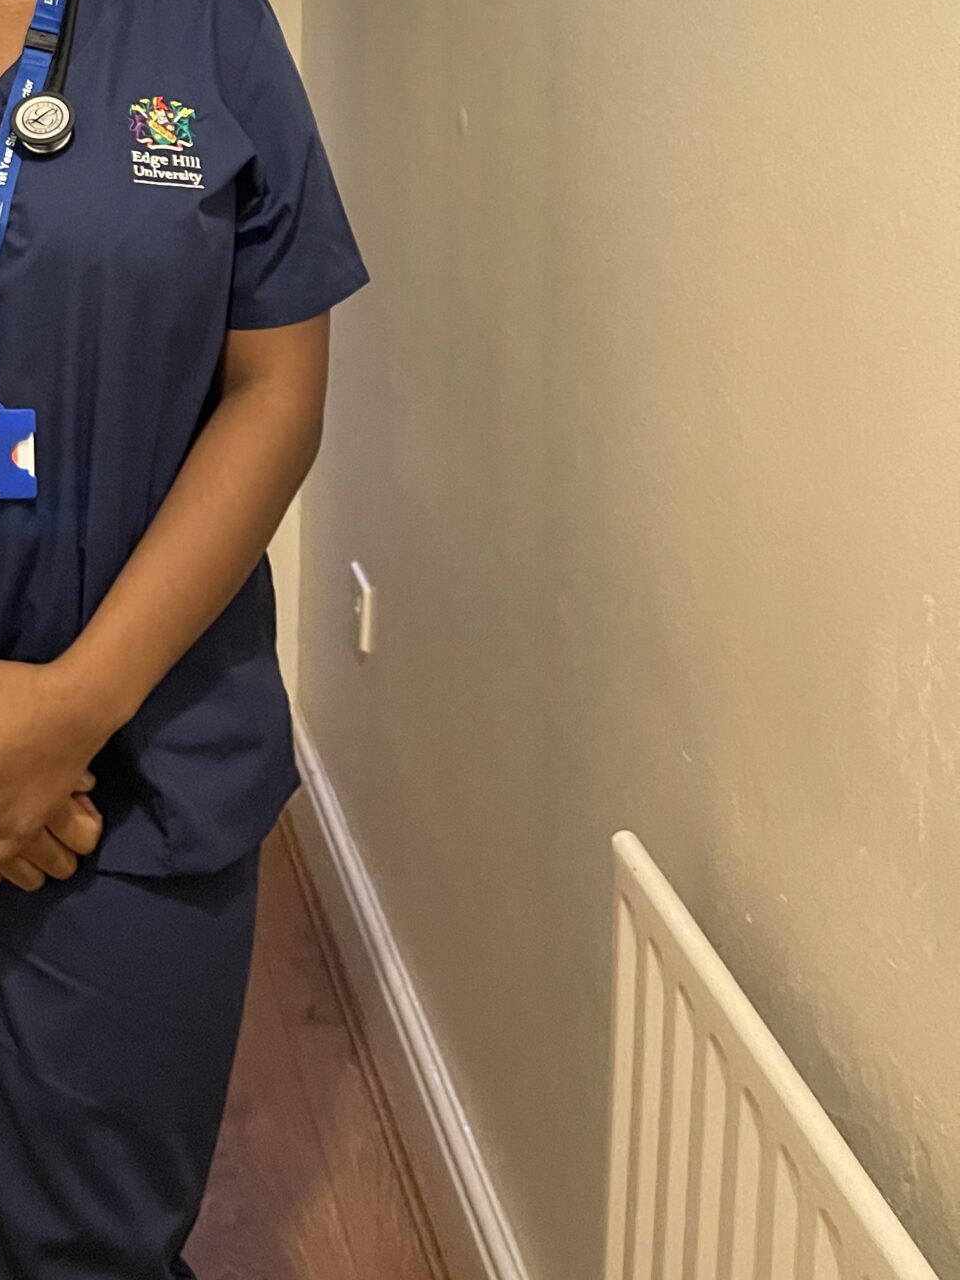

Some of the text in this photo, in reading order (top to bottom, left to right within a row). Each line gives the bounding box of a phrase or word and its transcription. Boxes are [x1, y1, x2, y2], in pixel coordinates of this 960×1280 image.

[0, 146, 15, 170] Year
[131, 150, 201, 169] Edge Hill
[133, 165, 203, 185] University
